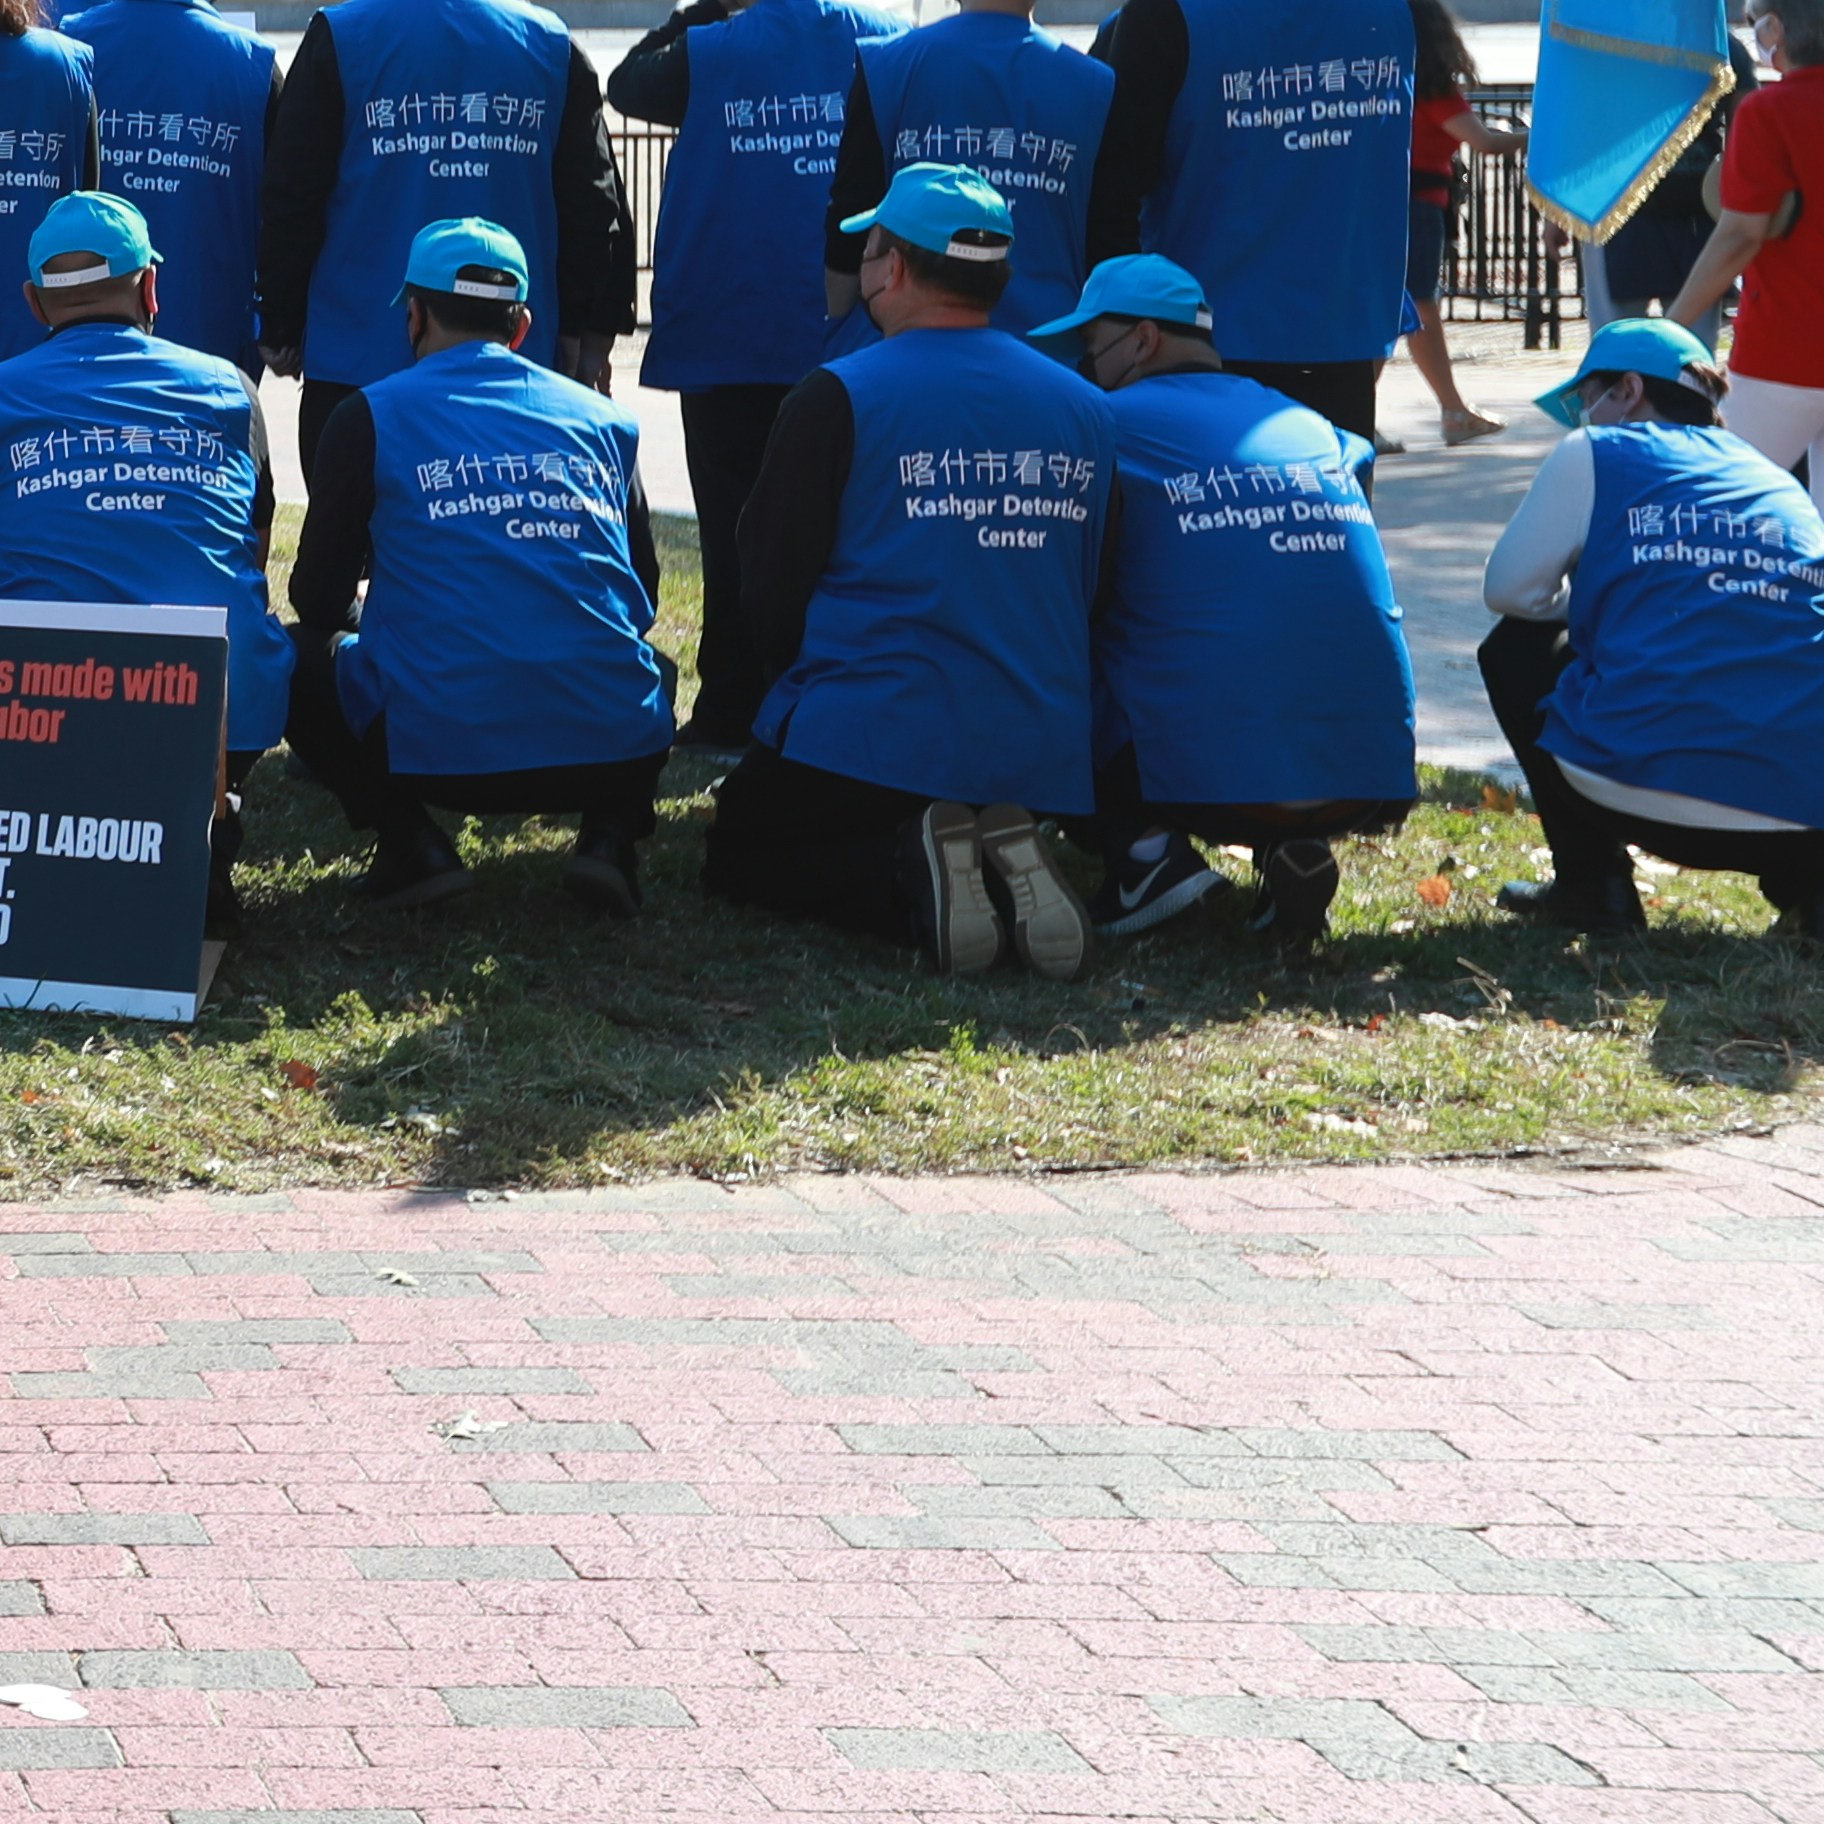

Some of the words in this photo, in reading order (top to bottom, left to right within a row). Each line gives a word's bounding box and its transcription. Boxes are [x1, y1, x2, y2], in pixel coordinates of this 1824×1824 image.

[1222, 55, 1401, 103] 喀什市看守所
[364, 91, 547, 131] 喀什市看守所
[725, 91, 846, 129] 喀什市看
[1226, 105, 1306, 130] Kashgar
[98, 107, 242, 154] 什市看守所
[372, 131, 447, 156] Kashgar
[452, 131, 539, 155] Detention
[730, 131, 814, 155] Kashgar
[1283, 128, 1353, 152] Center
[147, 146, 232, 179] Detention
[429, 158, 490, 177] Center
[794, 156, 837, 176] Cent
[123, 173, 181, 194] Center
[9, 424, 225, 472] 喀什市看守所
[16, 466, 109, 499] Kashgar
[113, 462, 228, 489] Detention
[85, 491, 166, 512] Center
[427, 492, 526, 521] Kashgar
[905, 492, 998, 522] Kashgar
[506, 518, 582, 539] Center
[1178, 504, 1288, 535] Kashgar
[977, 525, 1047, 549] Center
[1269, 530, 1347, 554] Center
[1632, 539, 1739, 569] Kashgar
[1743, 548, 1824, 590] Detenti
[1707, 571, 1790, 603] Center
[20, 657, 115, 701] made
[121, 660, 199, 706] with
[34, 812, 165, 865] LABOUR
